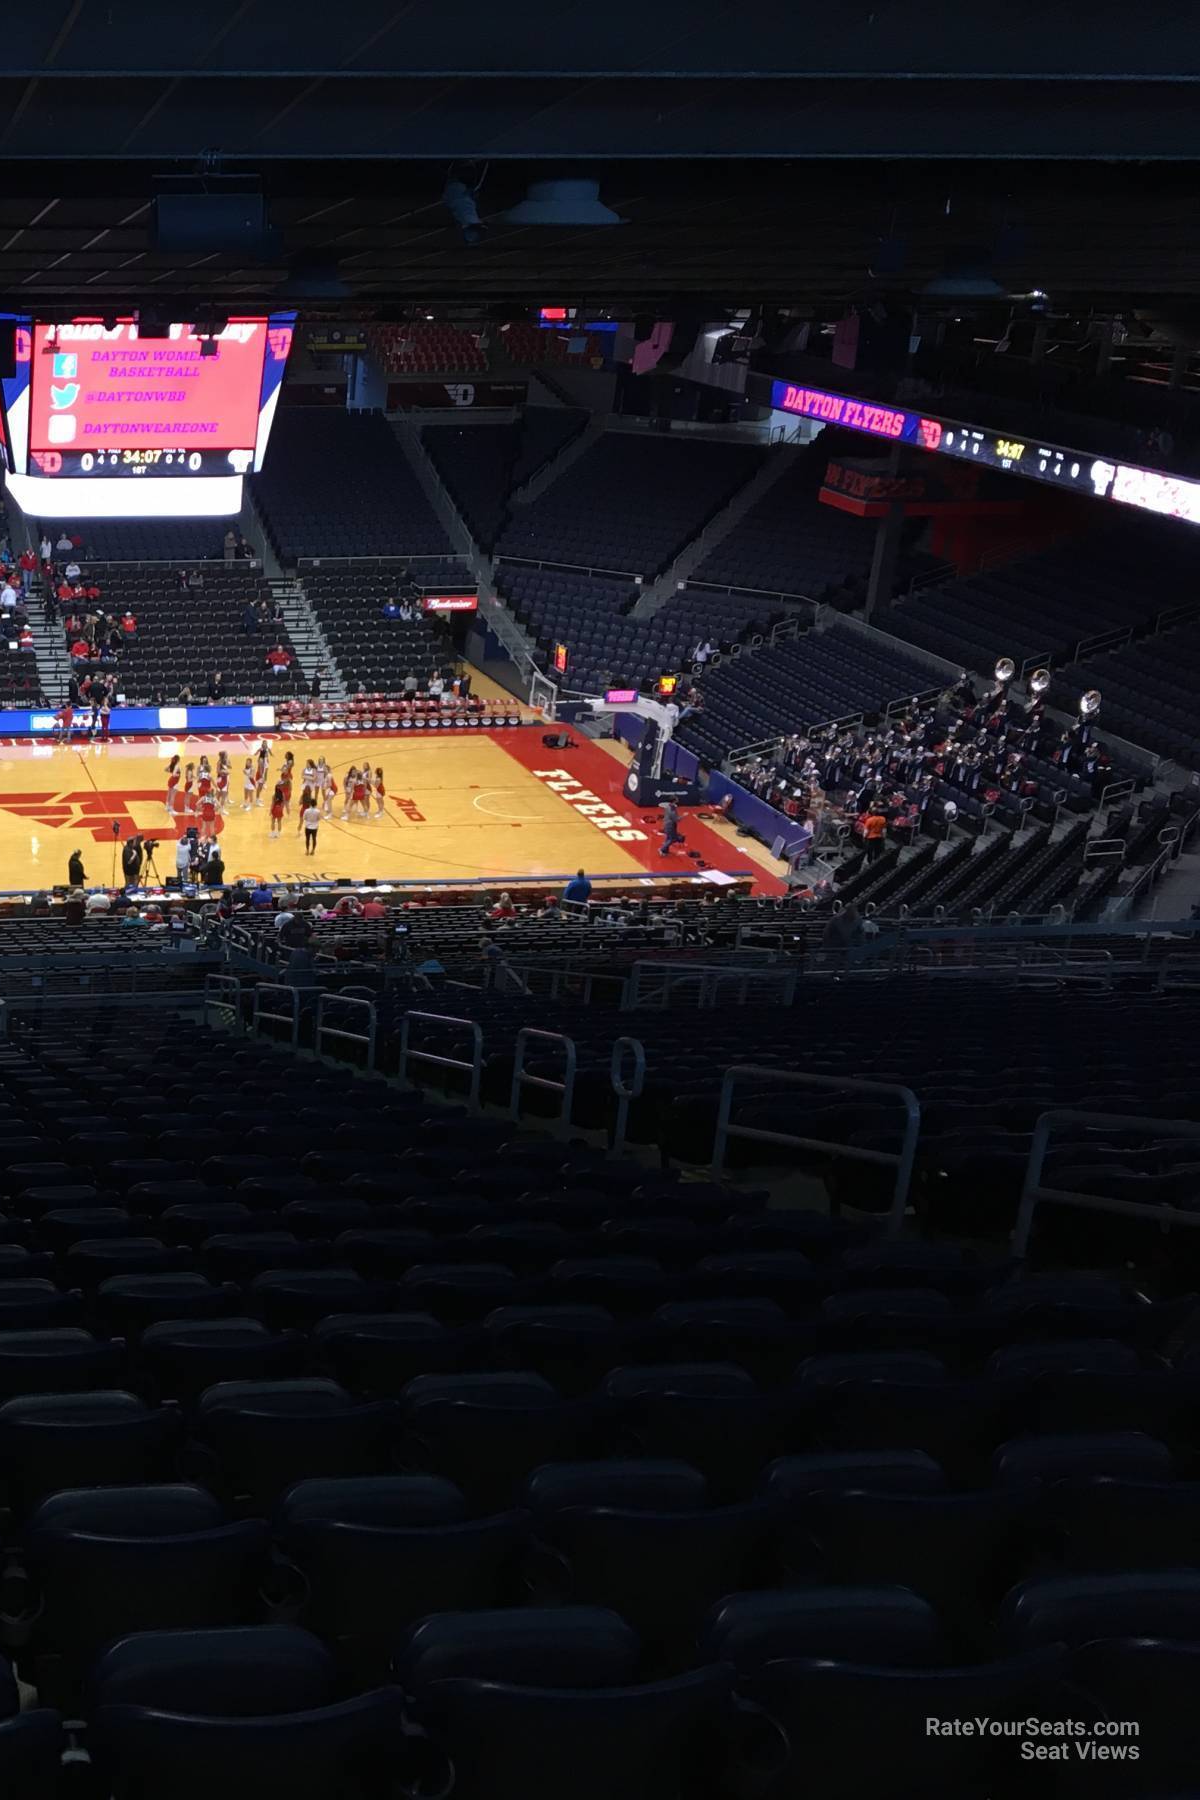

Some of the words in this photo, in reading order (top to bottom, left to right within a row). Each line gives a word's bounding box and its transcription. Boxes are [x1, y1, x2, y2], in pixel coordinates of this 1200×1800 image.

[91, 351, 148, 361] DAYTON
[108, 366, 200, 377] BASKETBALL
[783, 386, 845, 421] DAYTON
[843, 401, 905, 436] FLYERS
[83, 423, 219, 433] DAYTONWEAREONE
[81, 452, 94, 471] 0
[123, 449, 162, 463] 34:07
[188, 452, 202, 471] 0
[90, 735, 135, 745] OF
[151, 731, 310, 744] DAYTON
[532, 768, 648, 842] FLYERS
[272, 871, 340, 883] PNC
